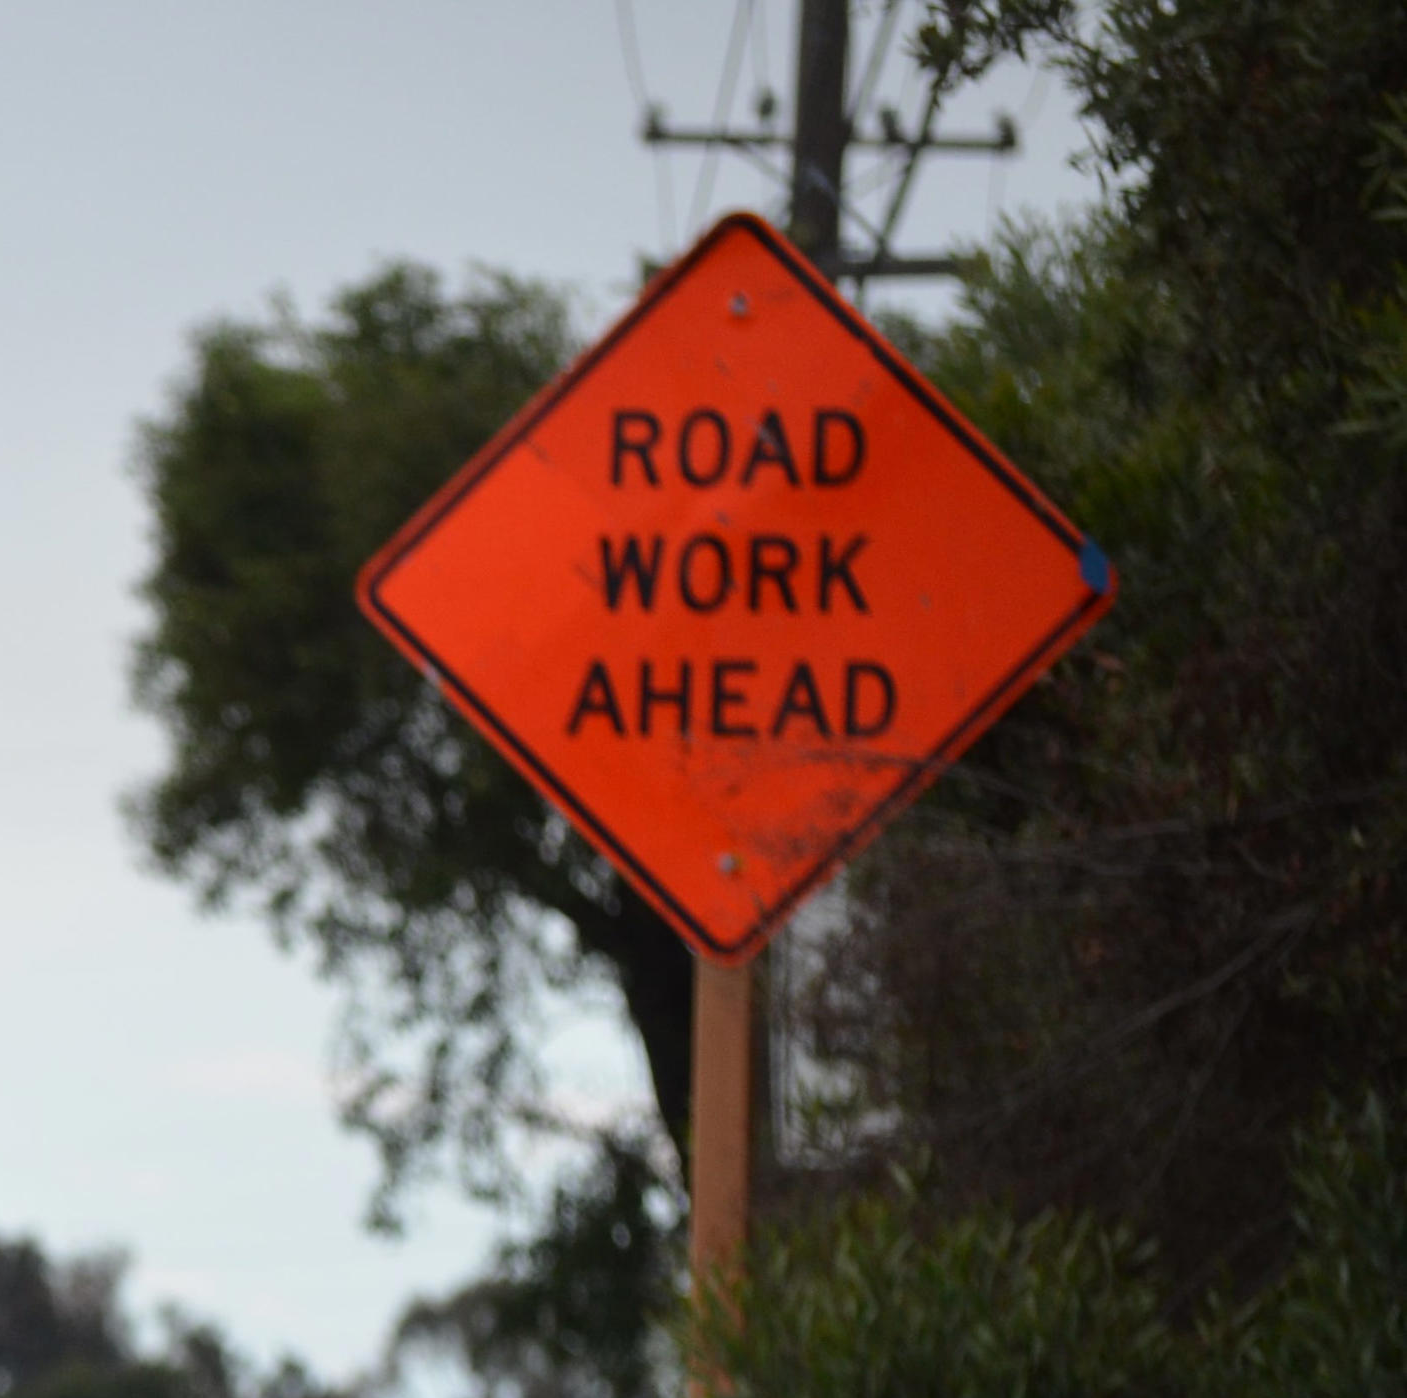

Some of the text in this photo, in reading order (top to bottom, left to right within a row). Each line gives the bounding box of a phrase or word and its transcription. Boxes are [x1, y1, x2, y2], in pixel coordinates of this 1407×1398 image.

[611, 409, 868, 488] ROAD
[599, 534, 870, 614] WORK
[566, 660, 898, 737] AHEAD
